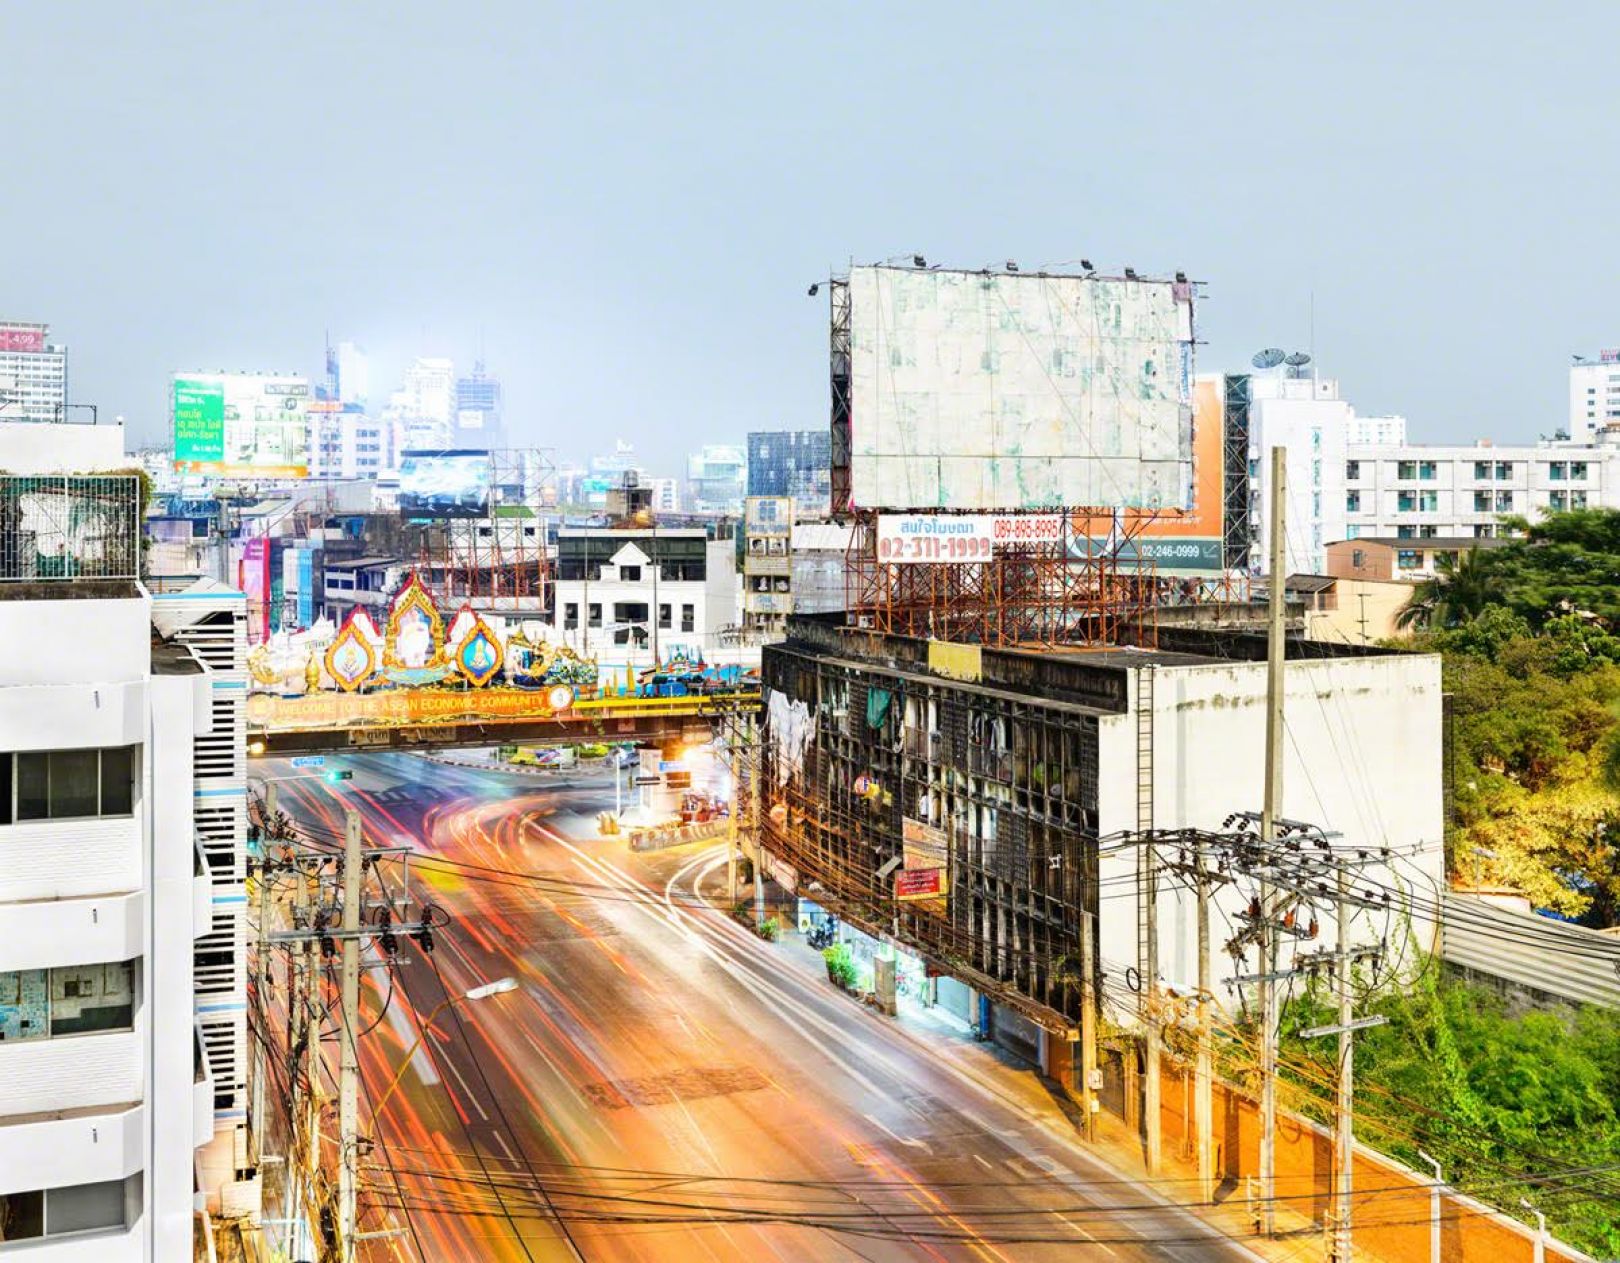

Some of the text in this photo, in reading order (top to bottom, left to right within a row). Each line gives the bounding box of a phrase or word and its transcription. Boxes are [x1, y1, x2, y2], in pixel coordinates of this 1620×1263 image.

[994, 519, 1058, 539] 089-895-8995
[879, 537, 991, 559] 02-311-1999
[1141, 544, 1200, 558] 02-246-0999
[278, 695, 544, 715] WELCOME TO THE ASEAN ECONOMIC COMMUNITY
